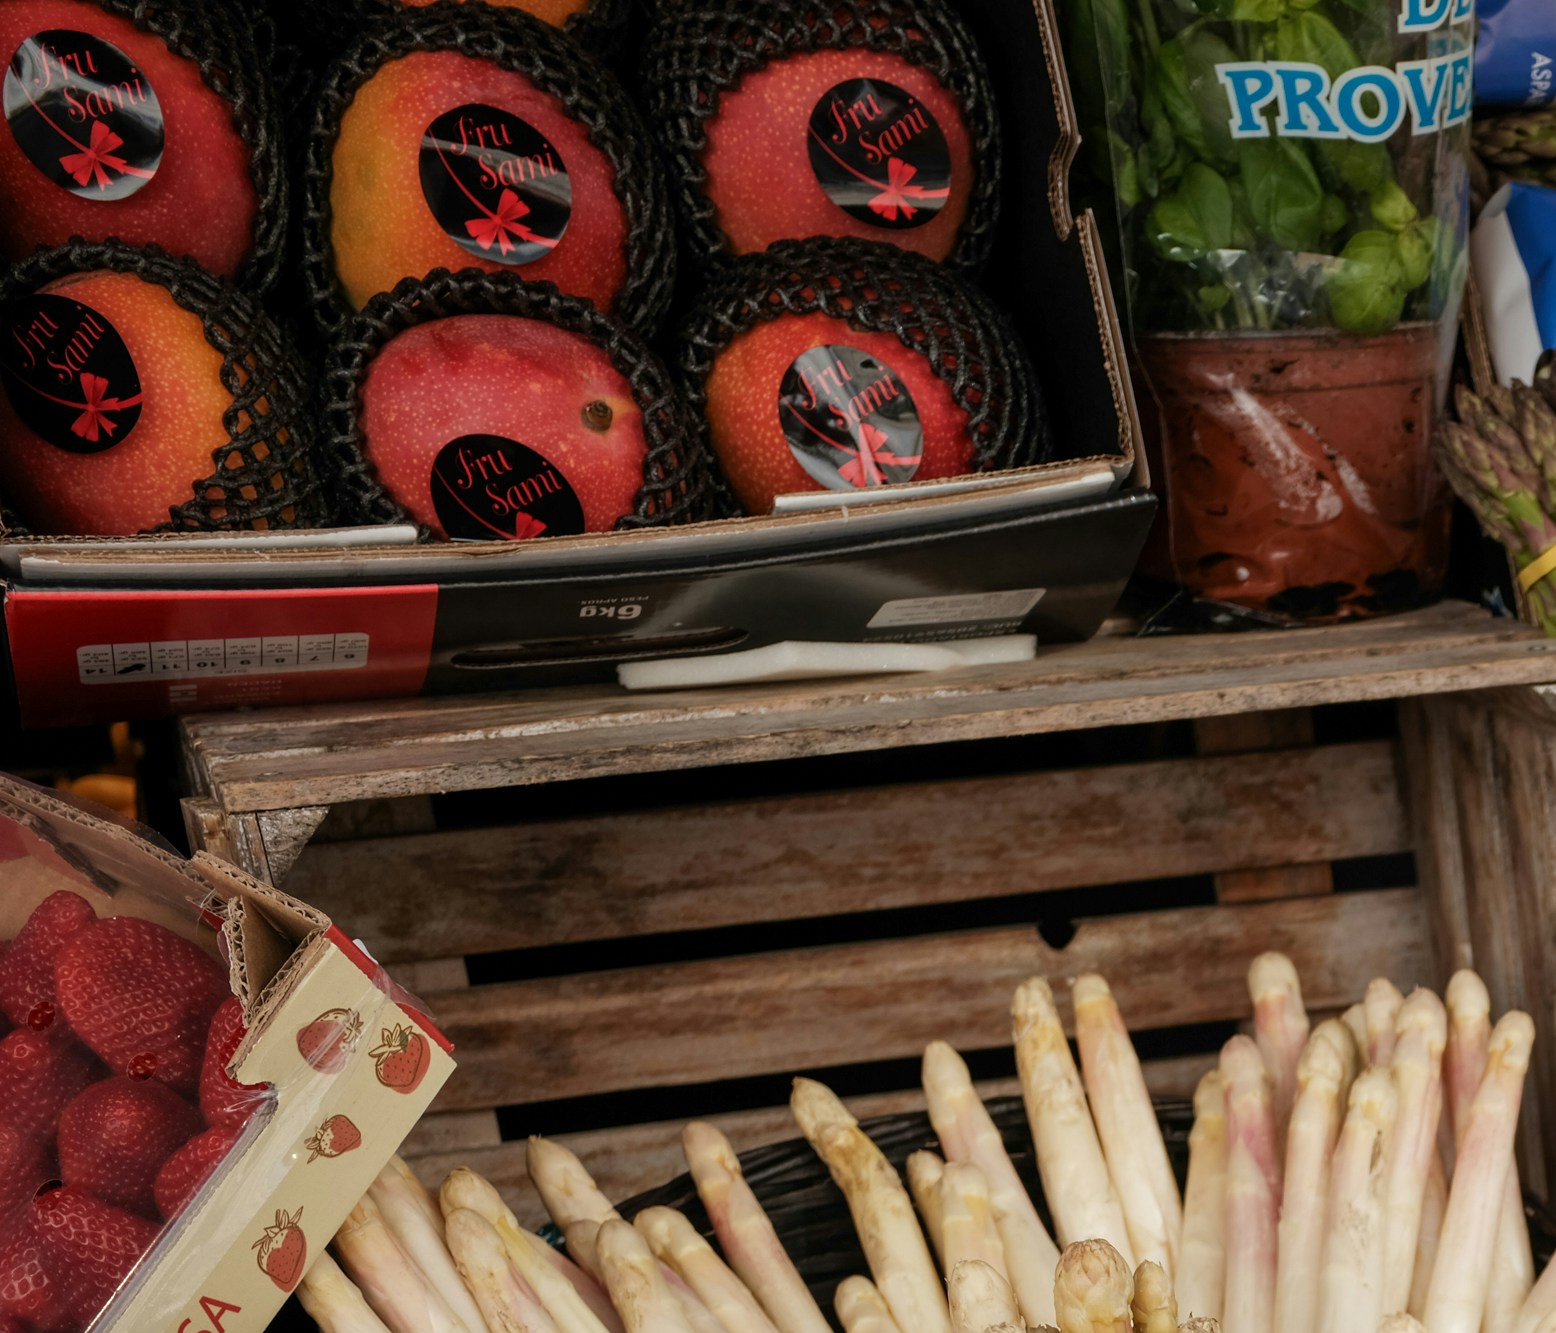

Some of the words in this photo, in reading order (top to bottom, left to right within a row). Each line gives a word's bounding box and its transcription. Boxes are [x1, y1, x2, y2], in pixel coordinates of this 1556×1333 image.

[63, 68, 147, 123] Sami
[858, 99, 930, 165] Sami
[478, 143, 559, 190] Sami
[47, 304, 104, 385] Sami
[828, 365, 899, 431] Sami
[485, 461, 563, 516] Sami
[579, 604, 642, 620] 6kg
